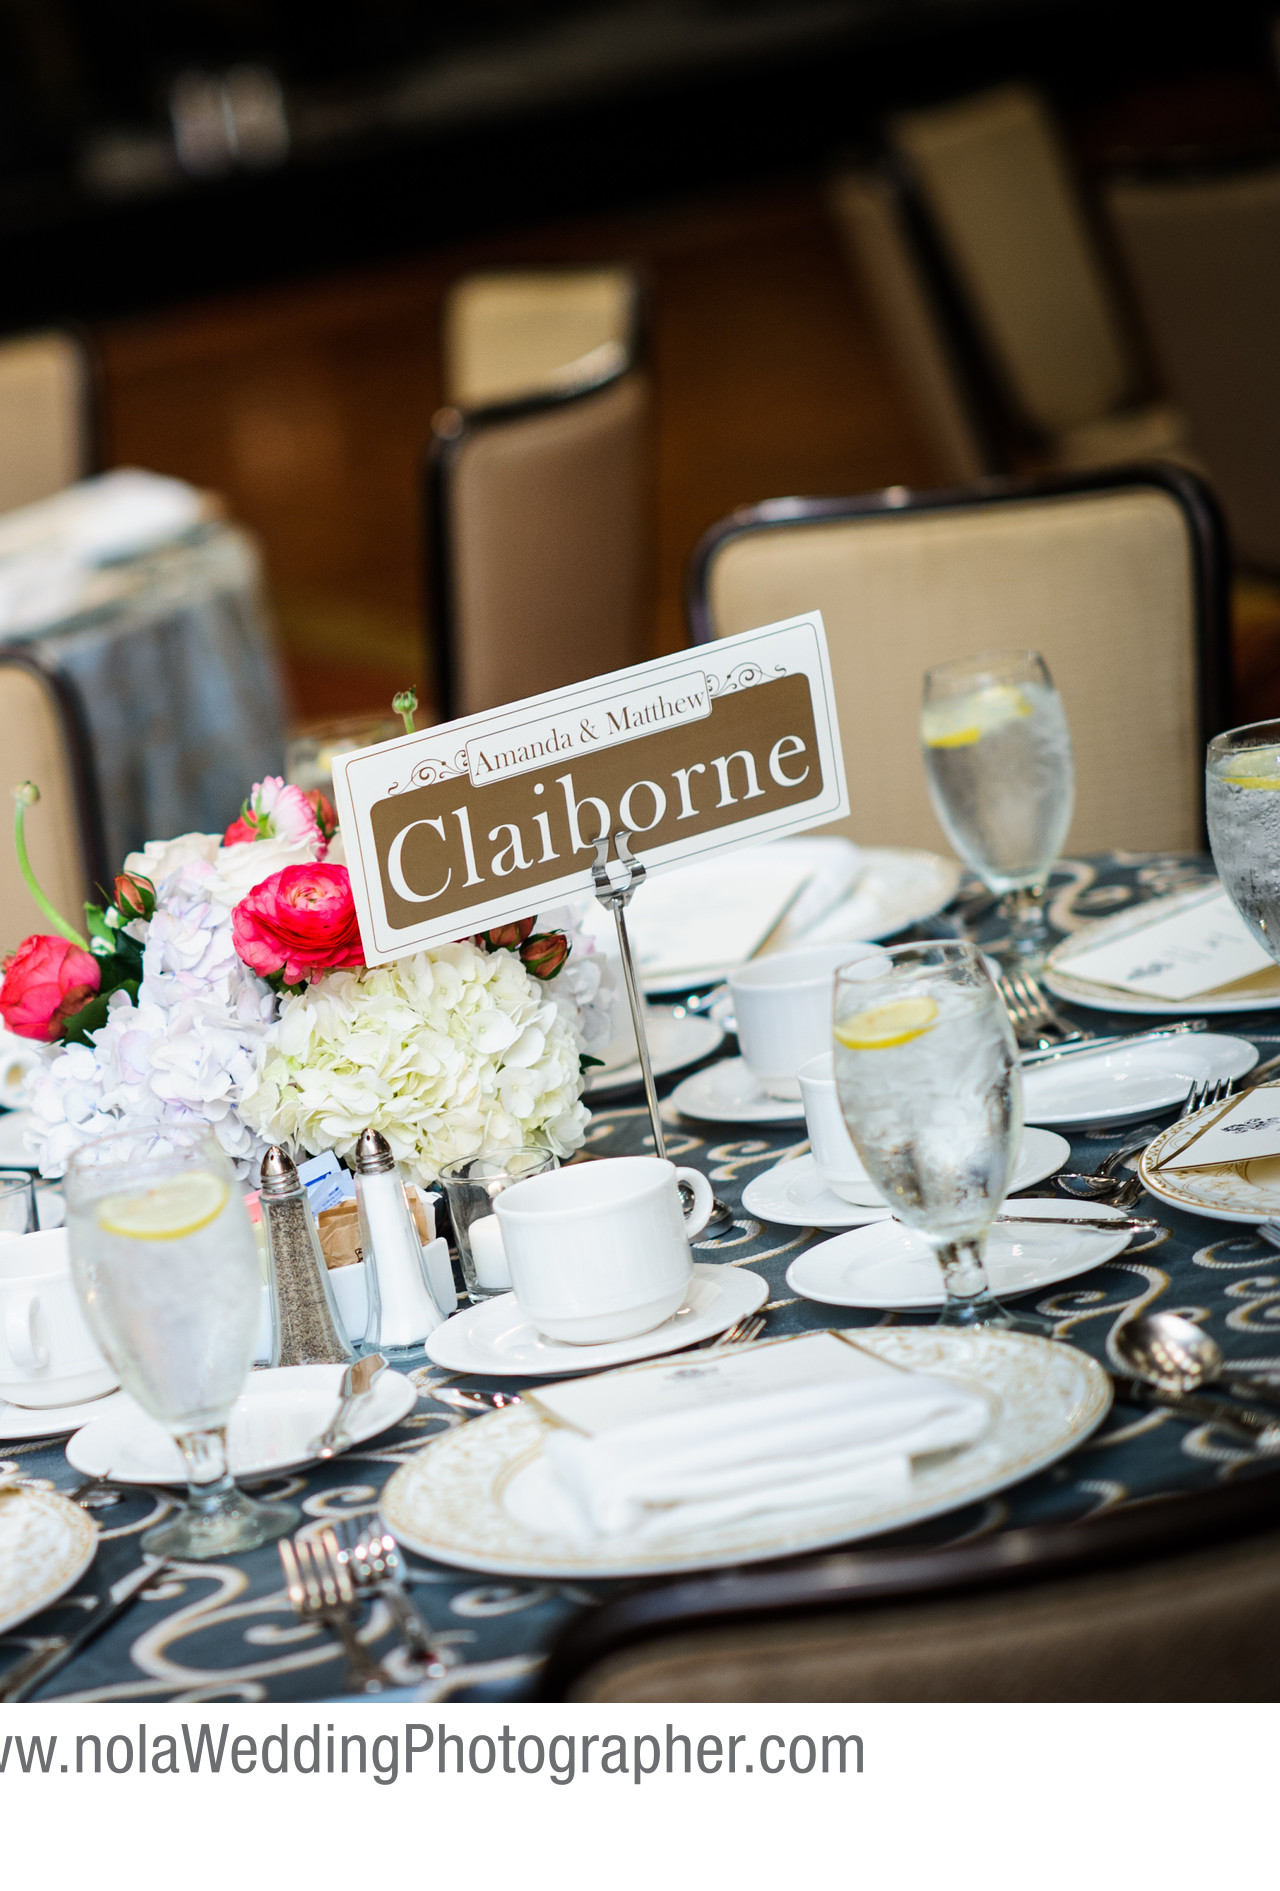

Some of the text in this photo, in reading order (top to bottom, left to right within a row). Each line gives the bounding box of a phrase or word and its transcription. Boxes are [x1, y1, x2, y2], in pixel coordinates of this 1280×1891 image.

[475, 692, 705, 777] Amanda & Matthew
[387, 734, 810, 903] Claiborne
